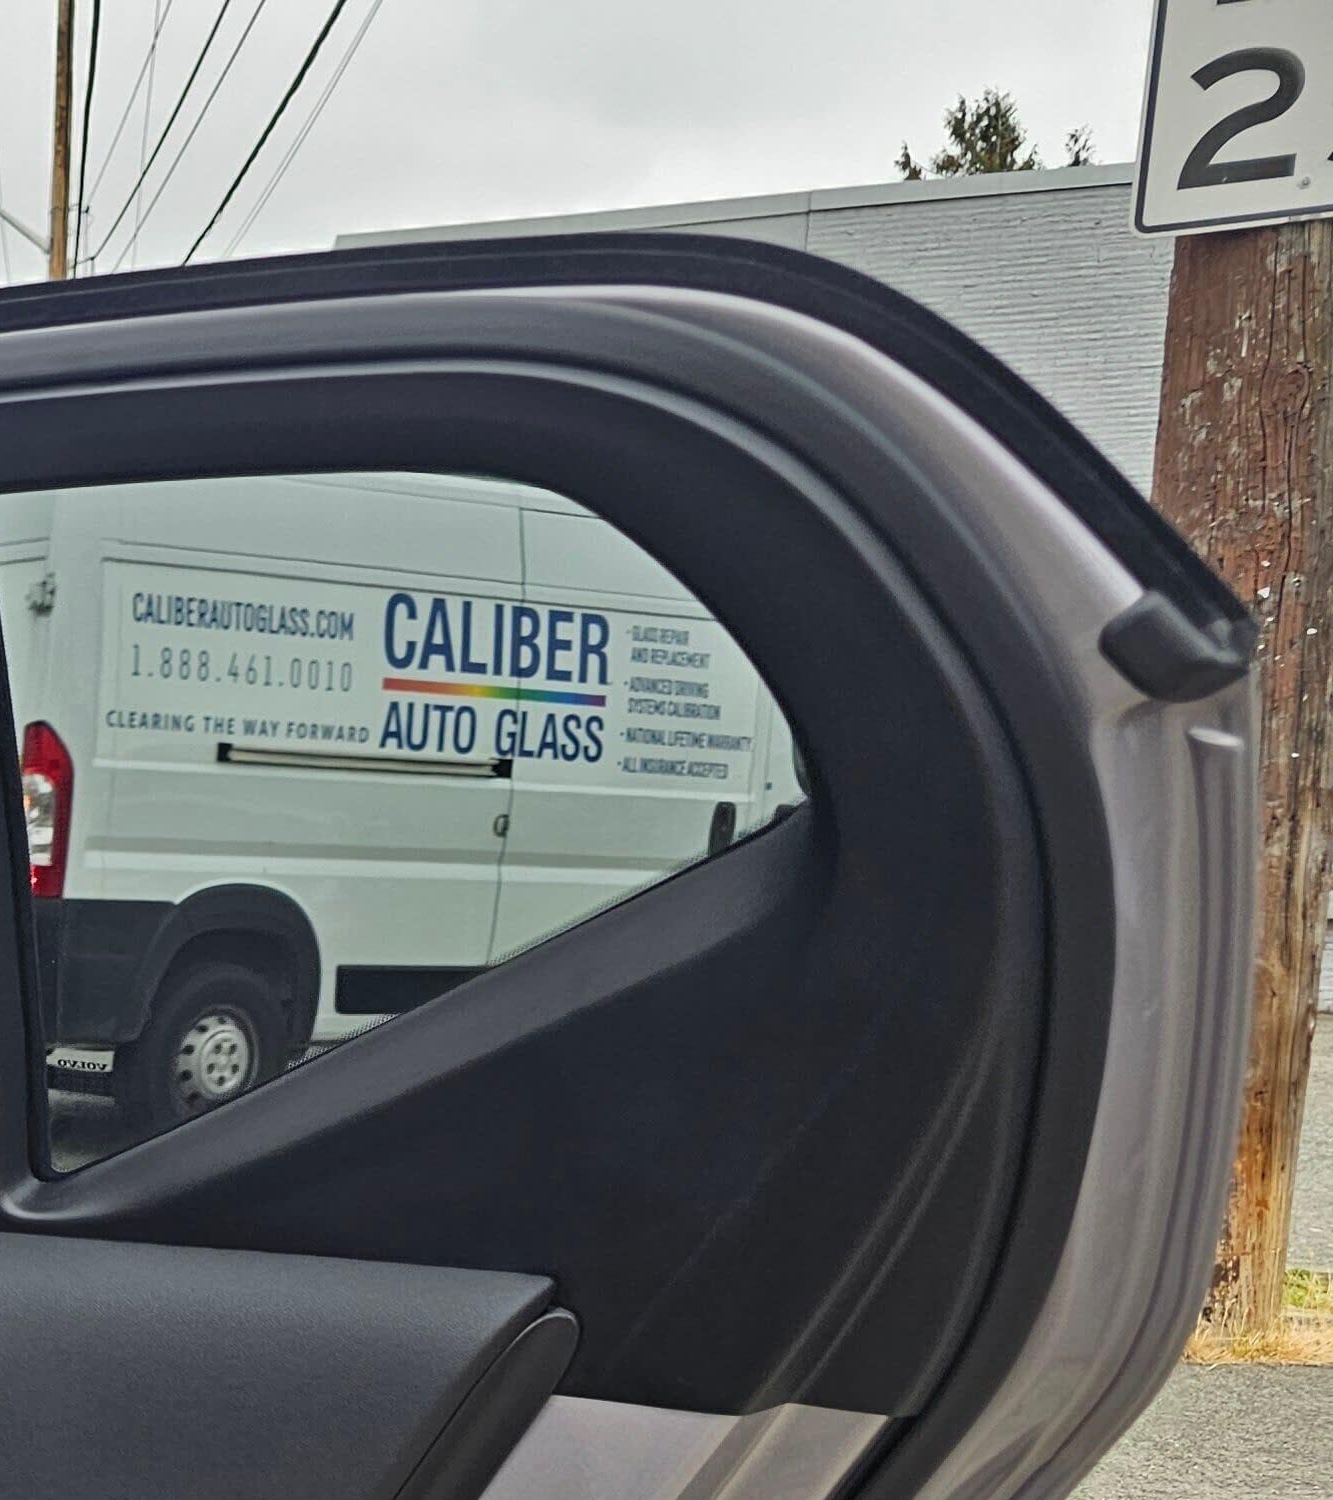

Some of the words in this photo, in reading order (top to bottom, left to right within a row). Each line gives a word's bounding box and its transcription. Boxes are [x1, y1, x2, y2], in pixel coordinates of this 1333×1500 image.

[1177, 47, 1333, 190] 2
[133, 592, 354, 641] CALIBERAUTOGLASS.COM
[384, 592, 610, 686] CALIBER
[131, 644, 353, 692] 1.888.461.0010
[106, 709, 195, 732] CLEARING
[203, 716, 235, 735] THE
[242, 718, 280, 738] WAY
[286, 722, 370, 744] FORWARD
[379, 701, 476, 755] AUTO
[495, 708, 604, 763] GLASS
